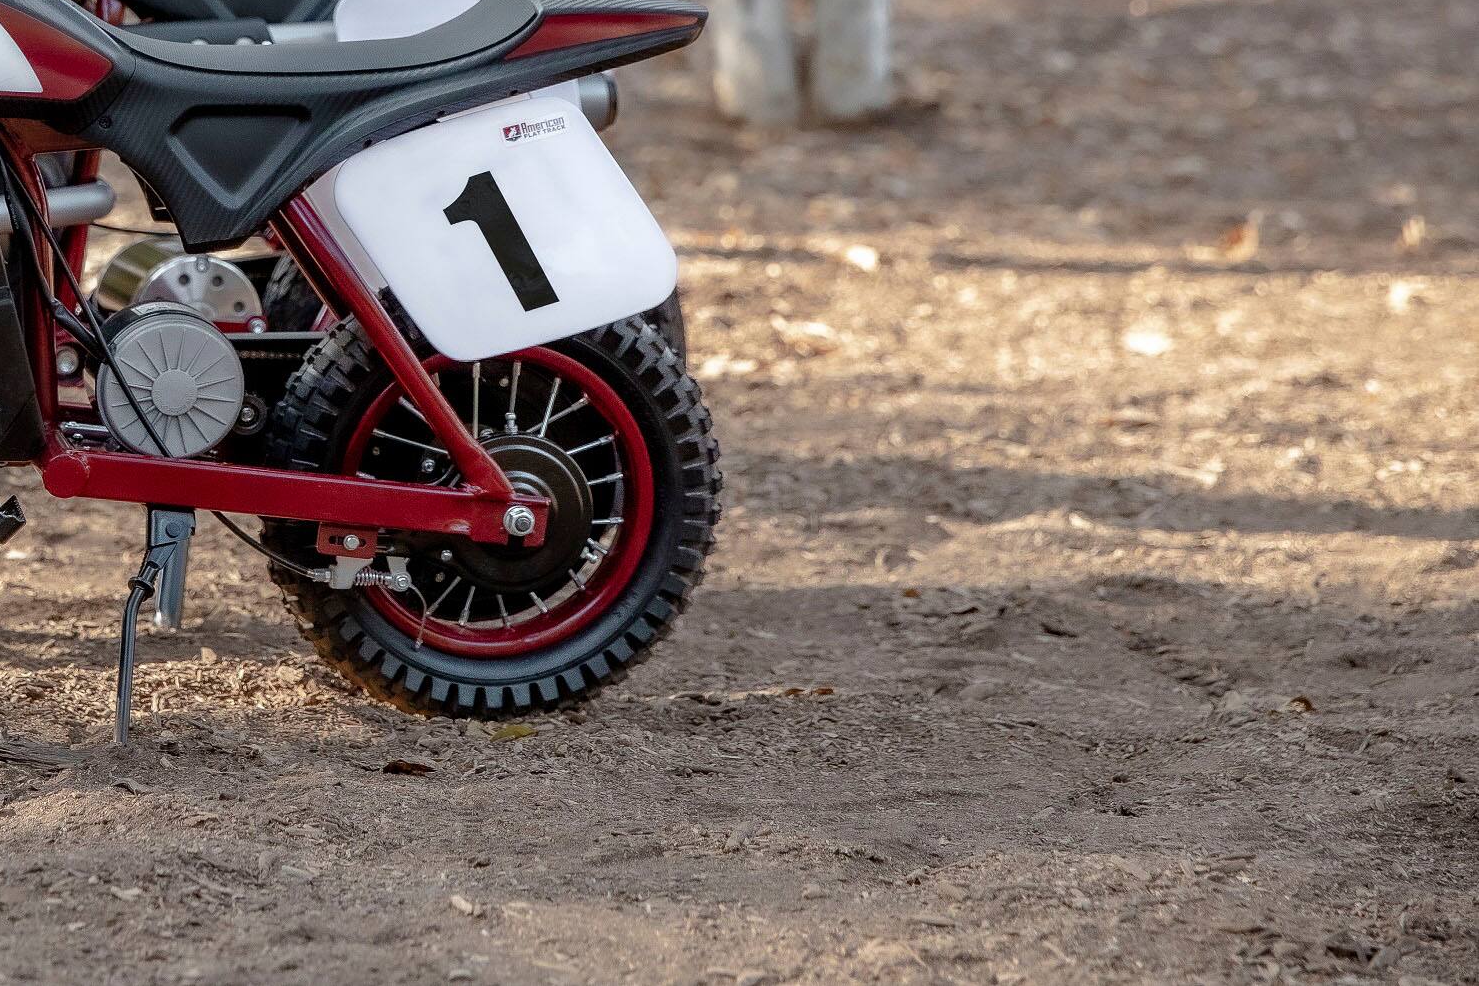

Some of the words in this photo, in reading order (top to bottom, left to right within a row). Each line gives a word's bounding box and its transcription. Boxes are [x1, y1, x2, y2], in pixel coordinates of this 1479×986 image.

[521, 117, 565, 134] American
[523, 130, 541, 139] FLAT
[542, 125, 566, 134] TRACK
[443, 171, 559, 312] 1
